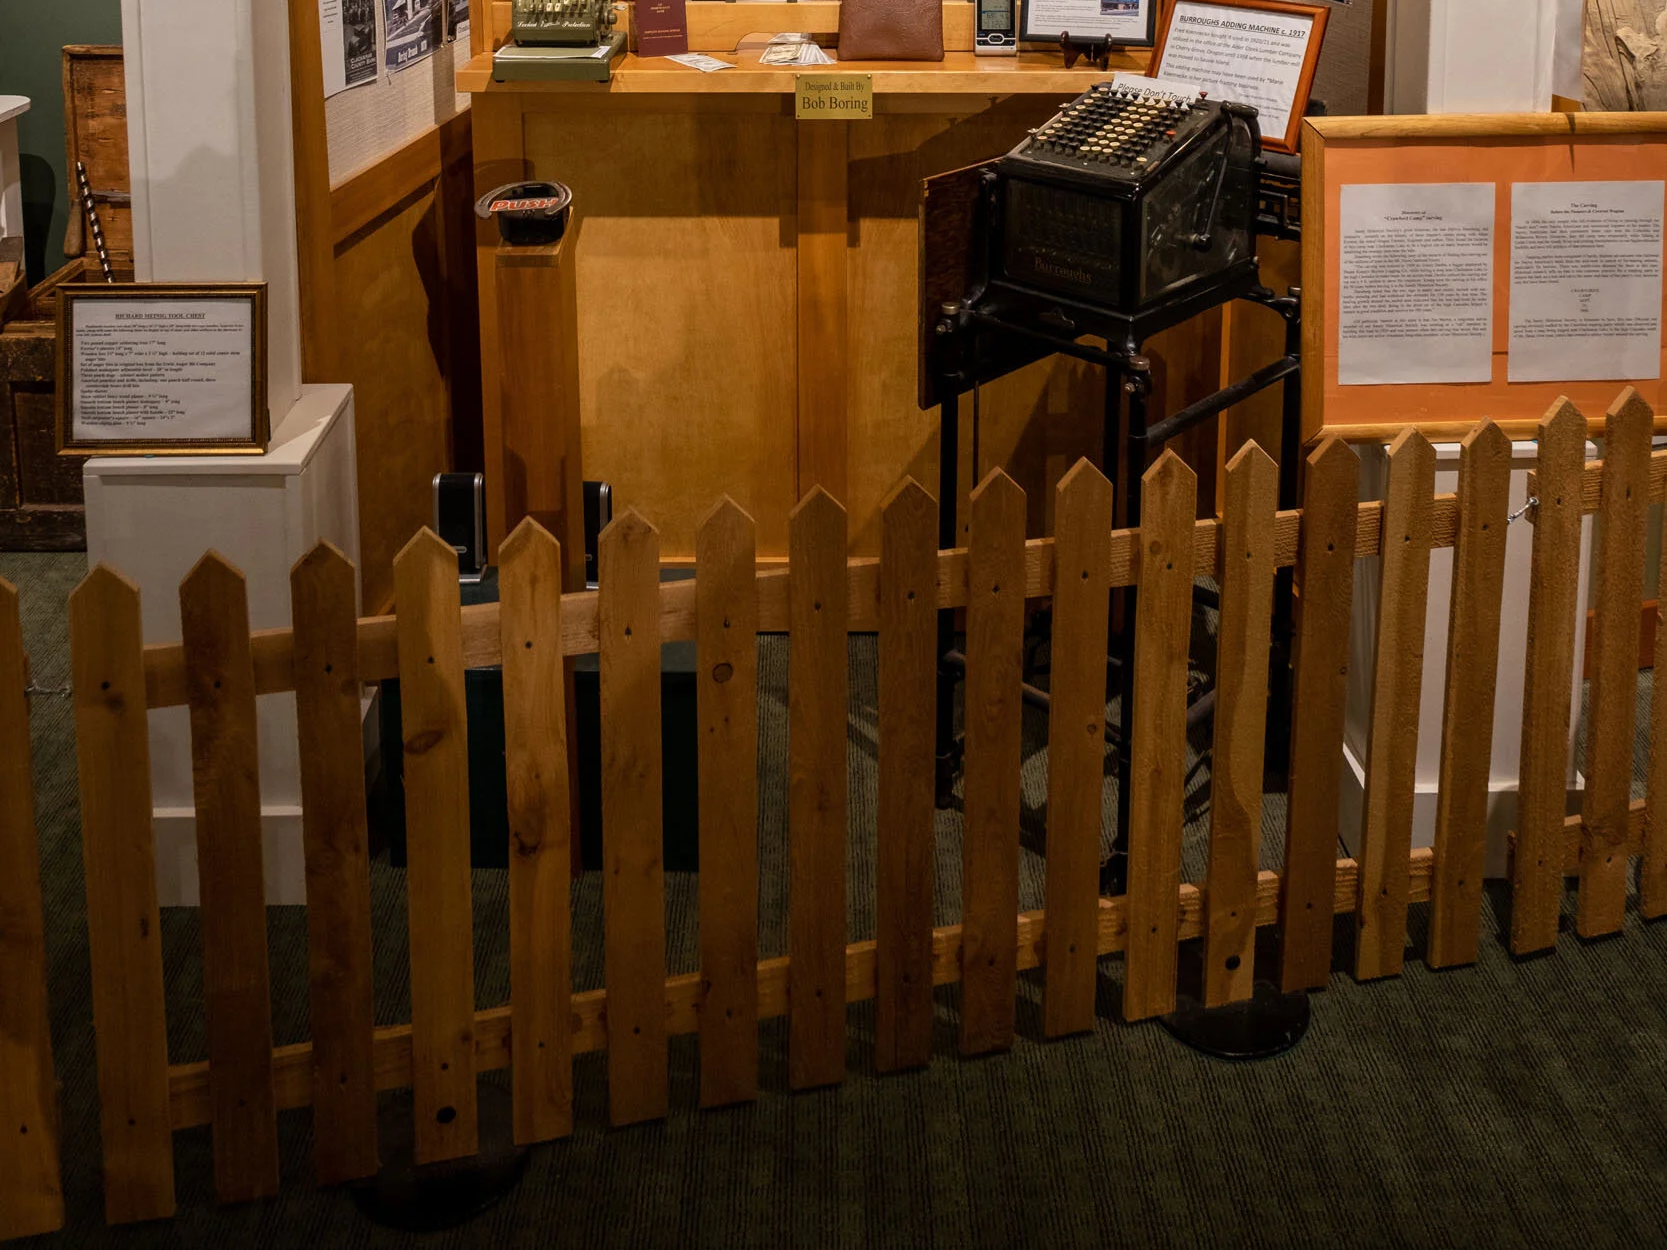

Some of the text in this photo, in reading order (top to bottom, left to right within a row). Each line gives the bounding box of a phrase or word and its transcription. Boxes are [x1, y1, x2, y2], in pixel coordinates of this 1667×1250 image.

[1180, 15, 1219, 26] BURROUGHS
[1220, 21, 1247, 30] ADDING
[1248, 24, 1280, 35] MACHINE
[1288, 30, 1306, 38] 1917
[1191, 65, 1211, 74] machine
[805, 82, 864, 93] Designed & Built By
[1117, 83, 1192, 102] Please Don't Touch
[802, 96, 868, 112] Bob Boring
[489, 197, 559, 212] PUSH
